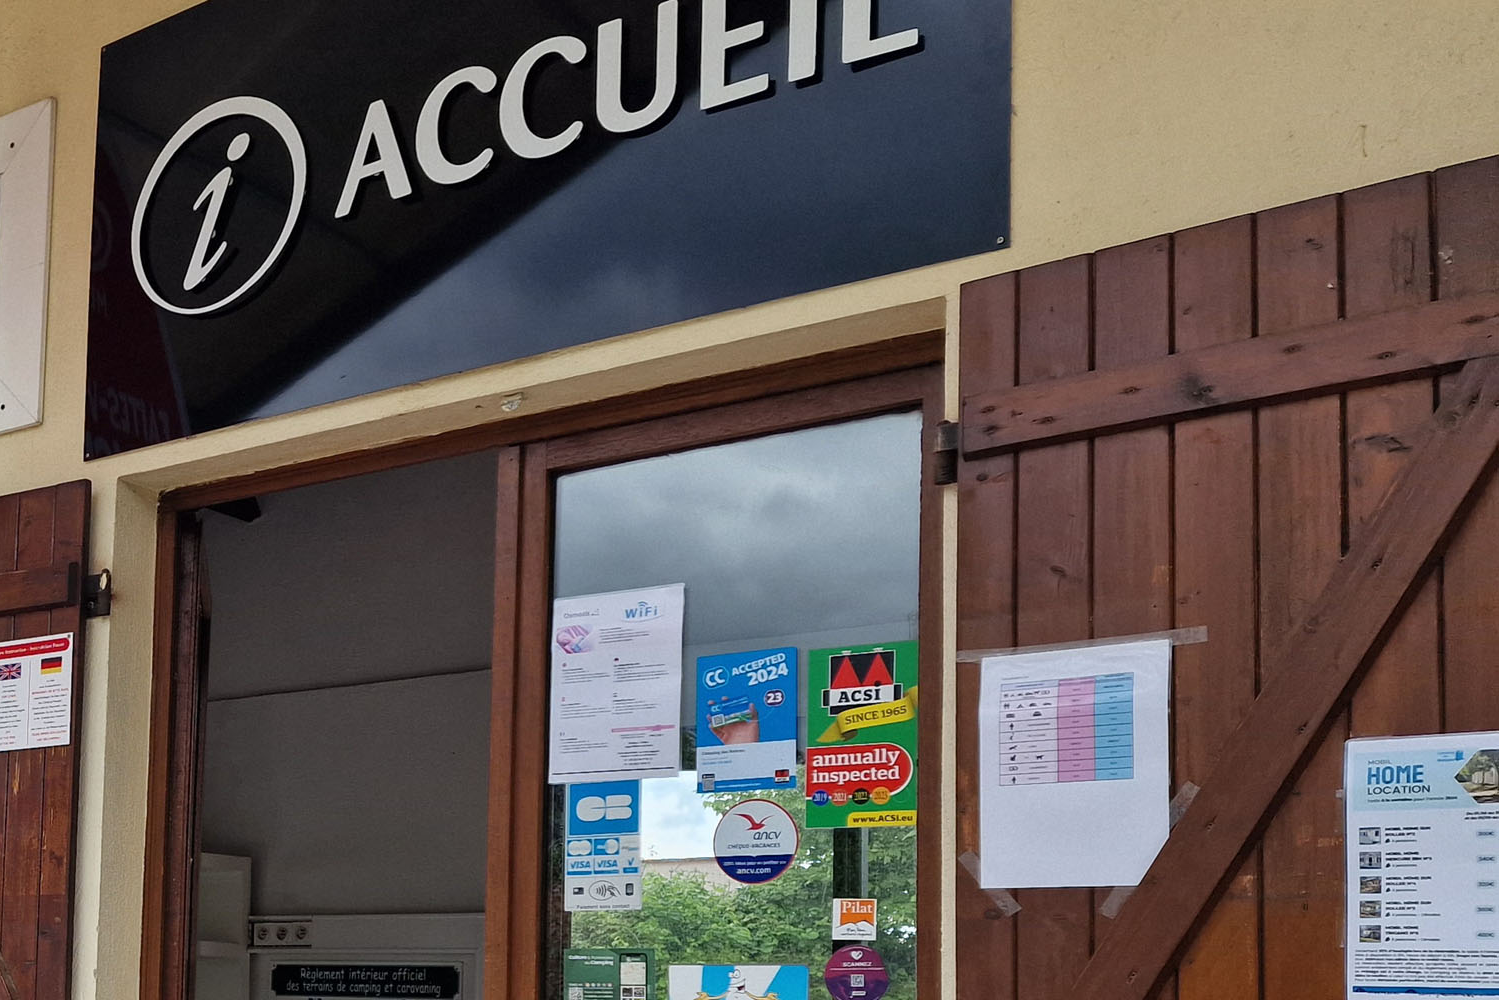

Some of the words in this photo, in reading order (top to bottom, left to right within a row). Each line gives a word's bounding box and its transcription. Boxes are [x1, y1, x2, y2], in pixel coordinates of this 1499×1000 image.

[334, 0, 919, 220] ACCUEIL
[732, 653, 786, 676] ACCEPTED
[706, 669, 725, 686] CC
[747, 663, 788, 686] 2024
[766, 692, 782, 703] 23
[845, 711, 880, 725] SINCE
[882, 705, 907, 717] 1965
[812, 748, 900, 767] annually
[812, 766, 900, 785] inspected
[1367, 765, 1424, 785] HOME
[1367, 785, 1431, 795] LOCATION
[753, 831, 781, 840] ancv
[570, 861, 591, 869] VISA
[597, 860, 618, 868] VISA
[736, 867, 771, 875] ancv.com
[842, 901, 873, 914] Pilat
[300, 967, 345, 982] Règlement
[349, 968, 388, 980] intérieur
[392, 968, 427, 981] officiel
[286, 980, 300, 991] des
[303, 981, 334, 992] terrains
[337, 982, 346, 992] de
[349, 983, 381, 996] camping
[384, 983, 393, 993] et
[396, 984, 442, 998] caravaning
